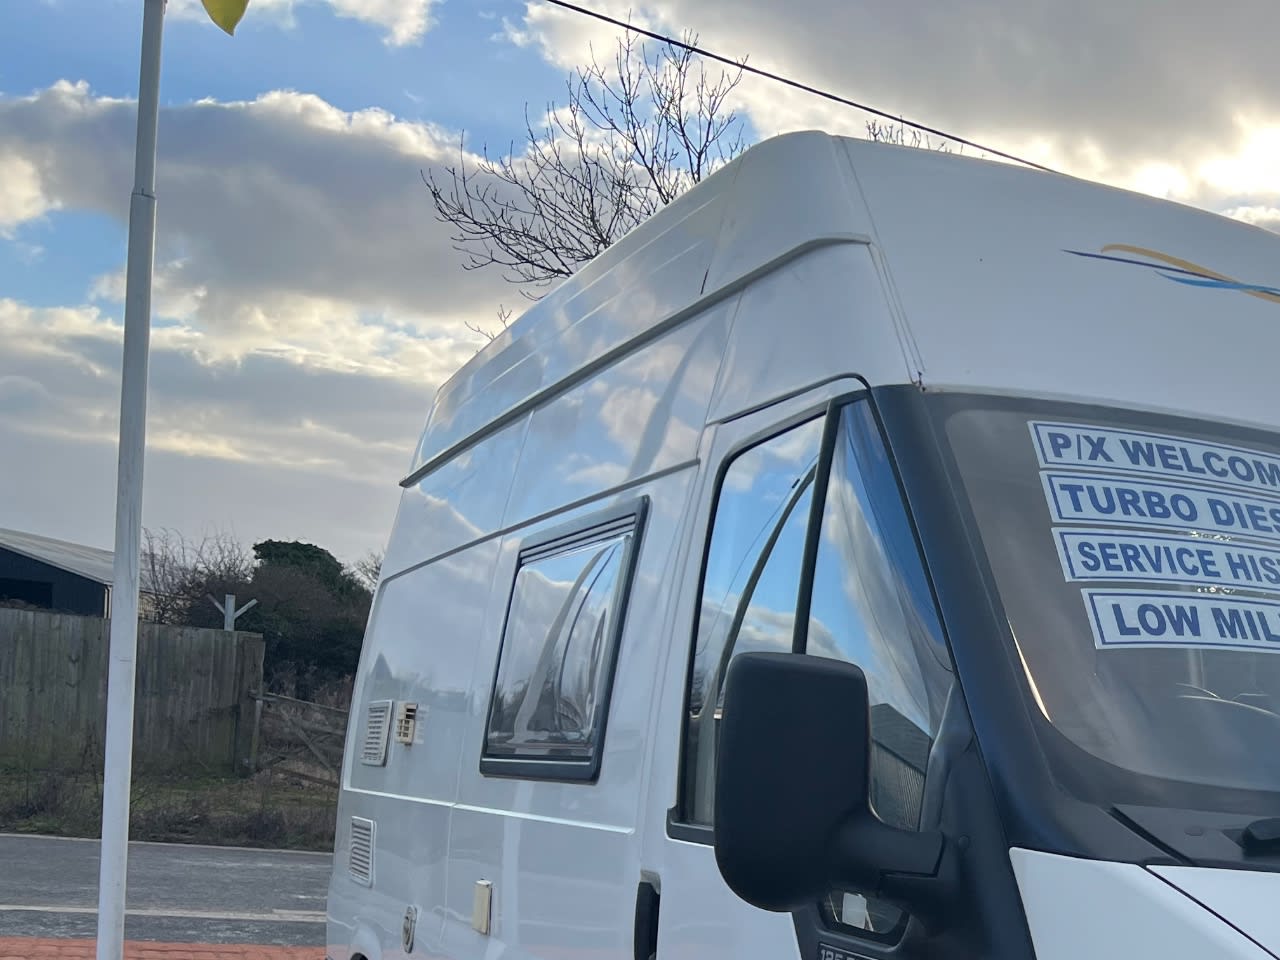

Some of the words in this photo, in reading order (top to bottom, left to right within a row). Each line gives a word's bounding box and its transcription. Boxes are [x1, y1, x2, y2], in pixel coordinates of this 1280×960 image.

[1047, 432, 1115, 463] P/X
[1060, 484, 1198, 522] TURBO
[1078, 541, 1220, 578] SERVICE
[1112, 603, 1200, 637] LOW
